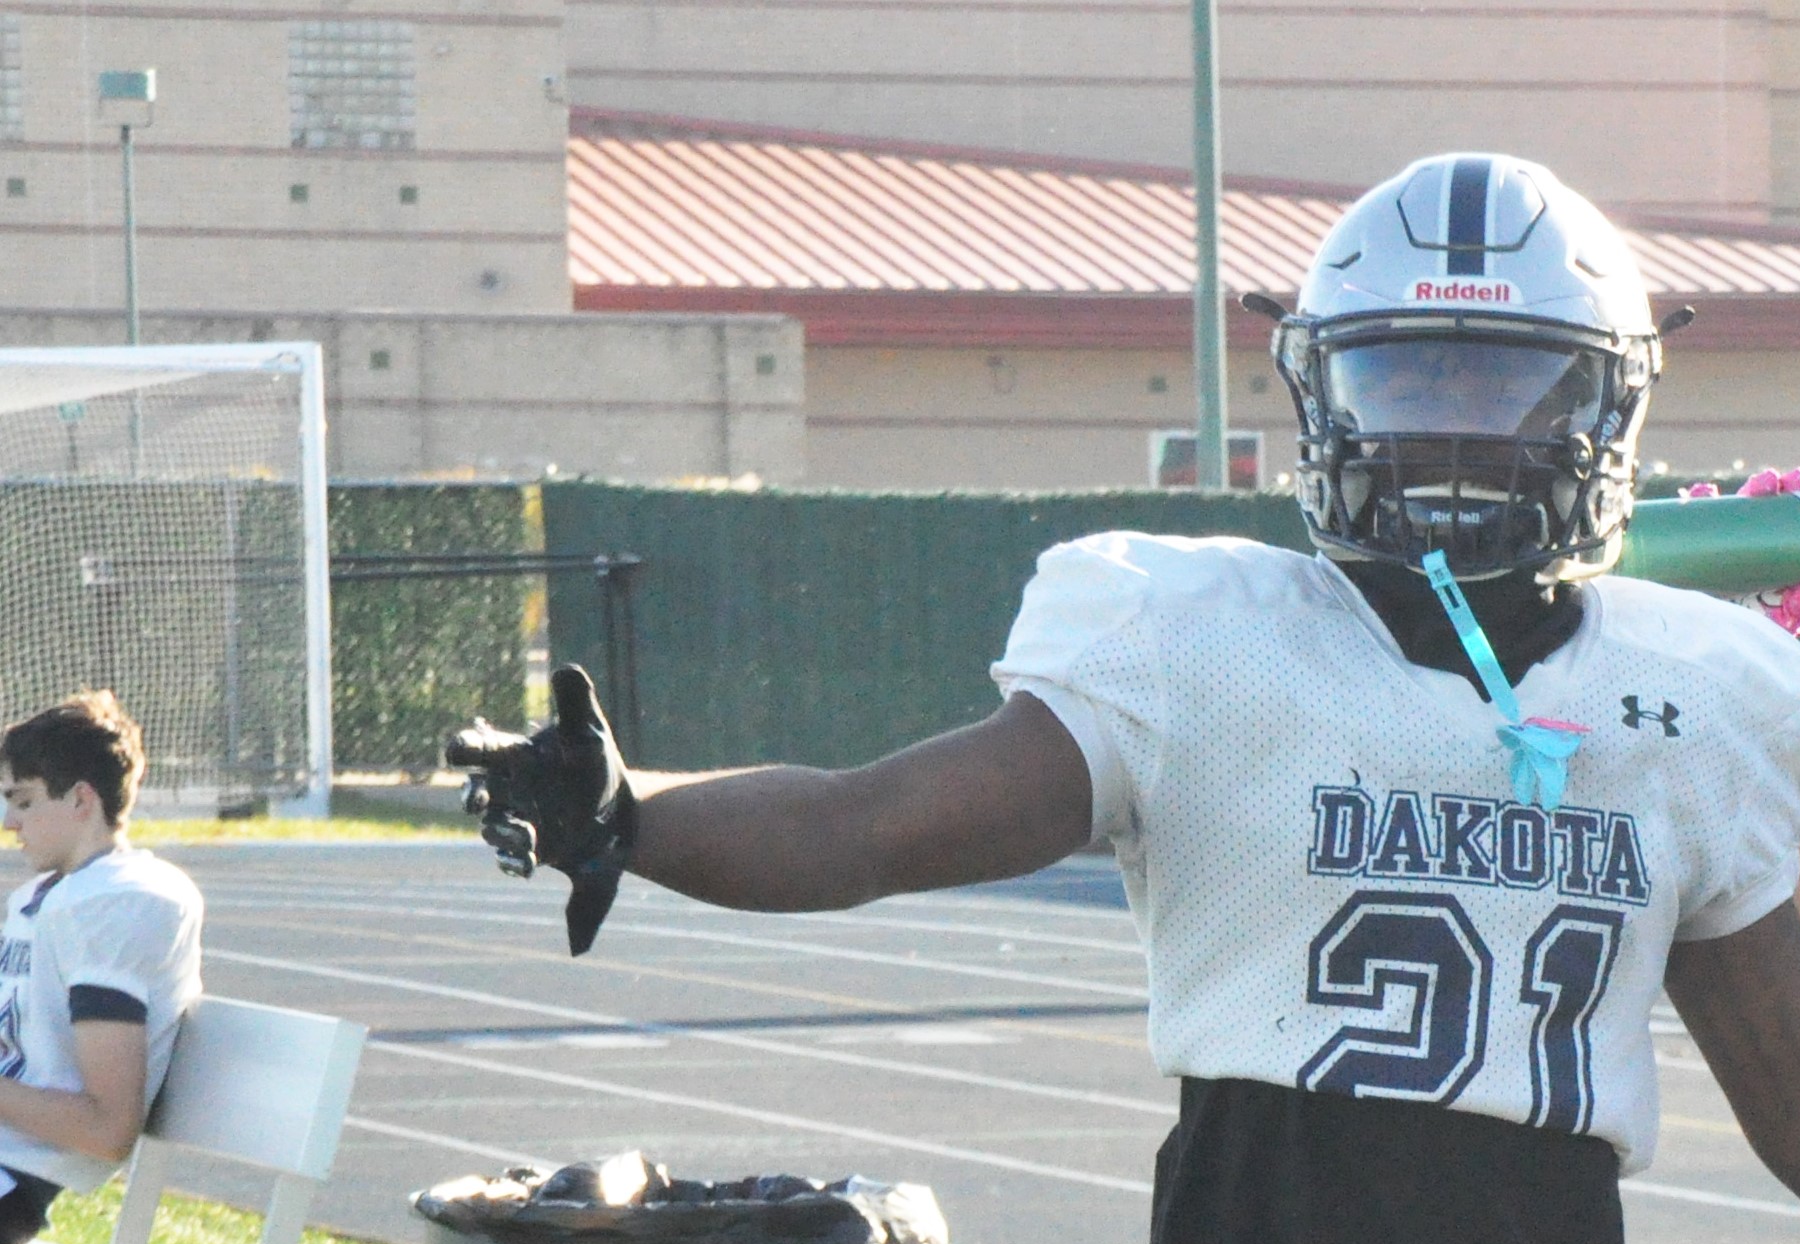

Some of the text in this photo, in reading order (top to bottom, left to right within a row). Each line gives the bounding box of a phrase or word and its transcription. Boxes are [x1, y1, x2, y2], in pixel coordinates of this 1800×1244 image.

[1416, 281, 1510, 302] Riddell
[1307, 786, 1652, 906] DAKOTA
[1297, 890, 1625, 1134] 21
